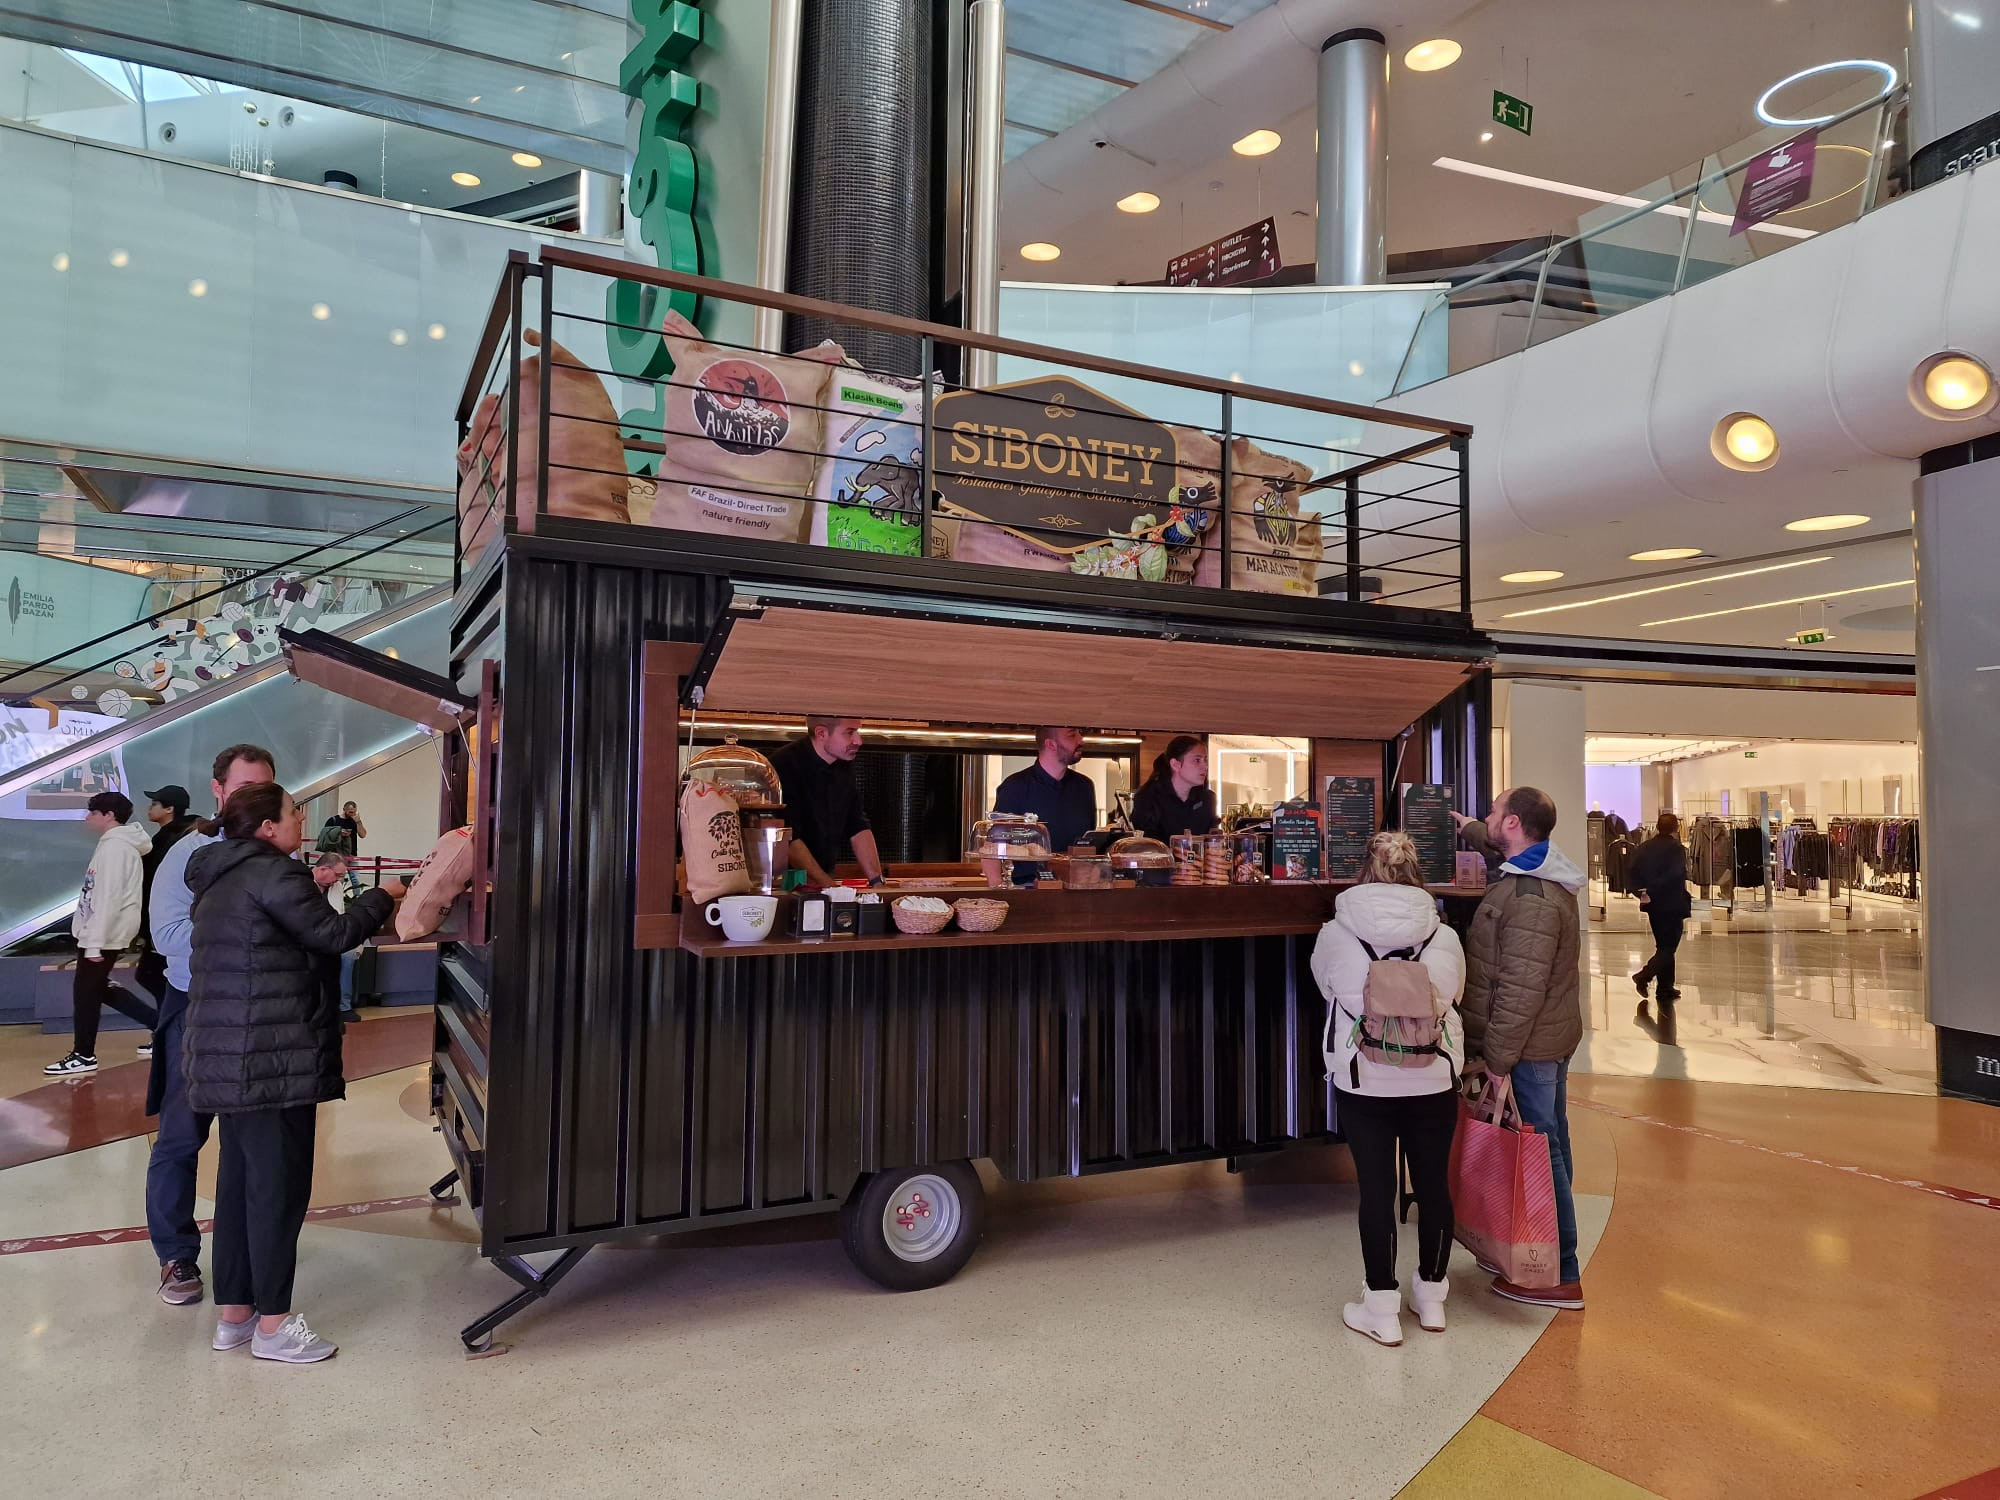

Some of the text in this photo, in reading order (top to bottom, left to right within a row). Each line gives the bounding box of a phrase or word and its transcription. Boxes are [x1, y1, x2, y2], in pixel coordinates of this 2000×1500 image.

[1269, 257, 1275, 272] 1
[844, 390, 875, 403] Klasik
[876, 396, 904, 411] Beans
[951, 420, 1163, 486] SIBONEY
[691, 487, 706, 498] FAF
[736, 500, 764, 512] Direct
[766, 504, 787, 513] Trade
[702, 508, 771, 530] nature friendly
[23, 592, 54, 603] EMILIA
[23, 599, 55, 611] PARDO
